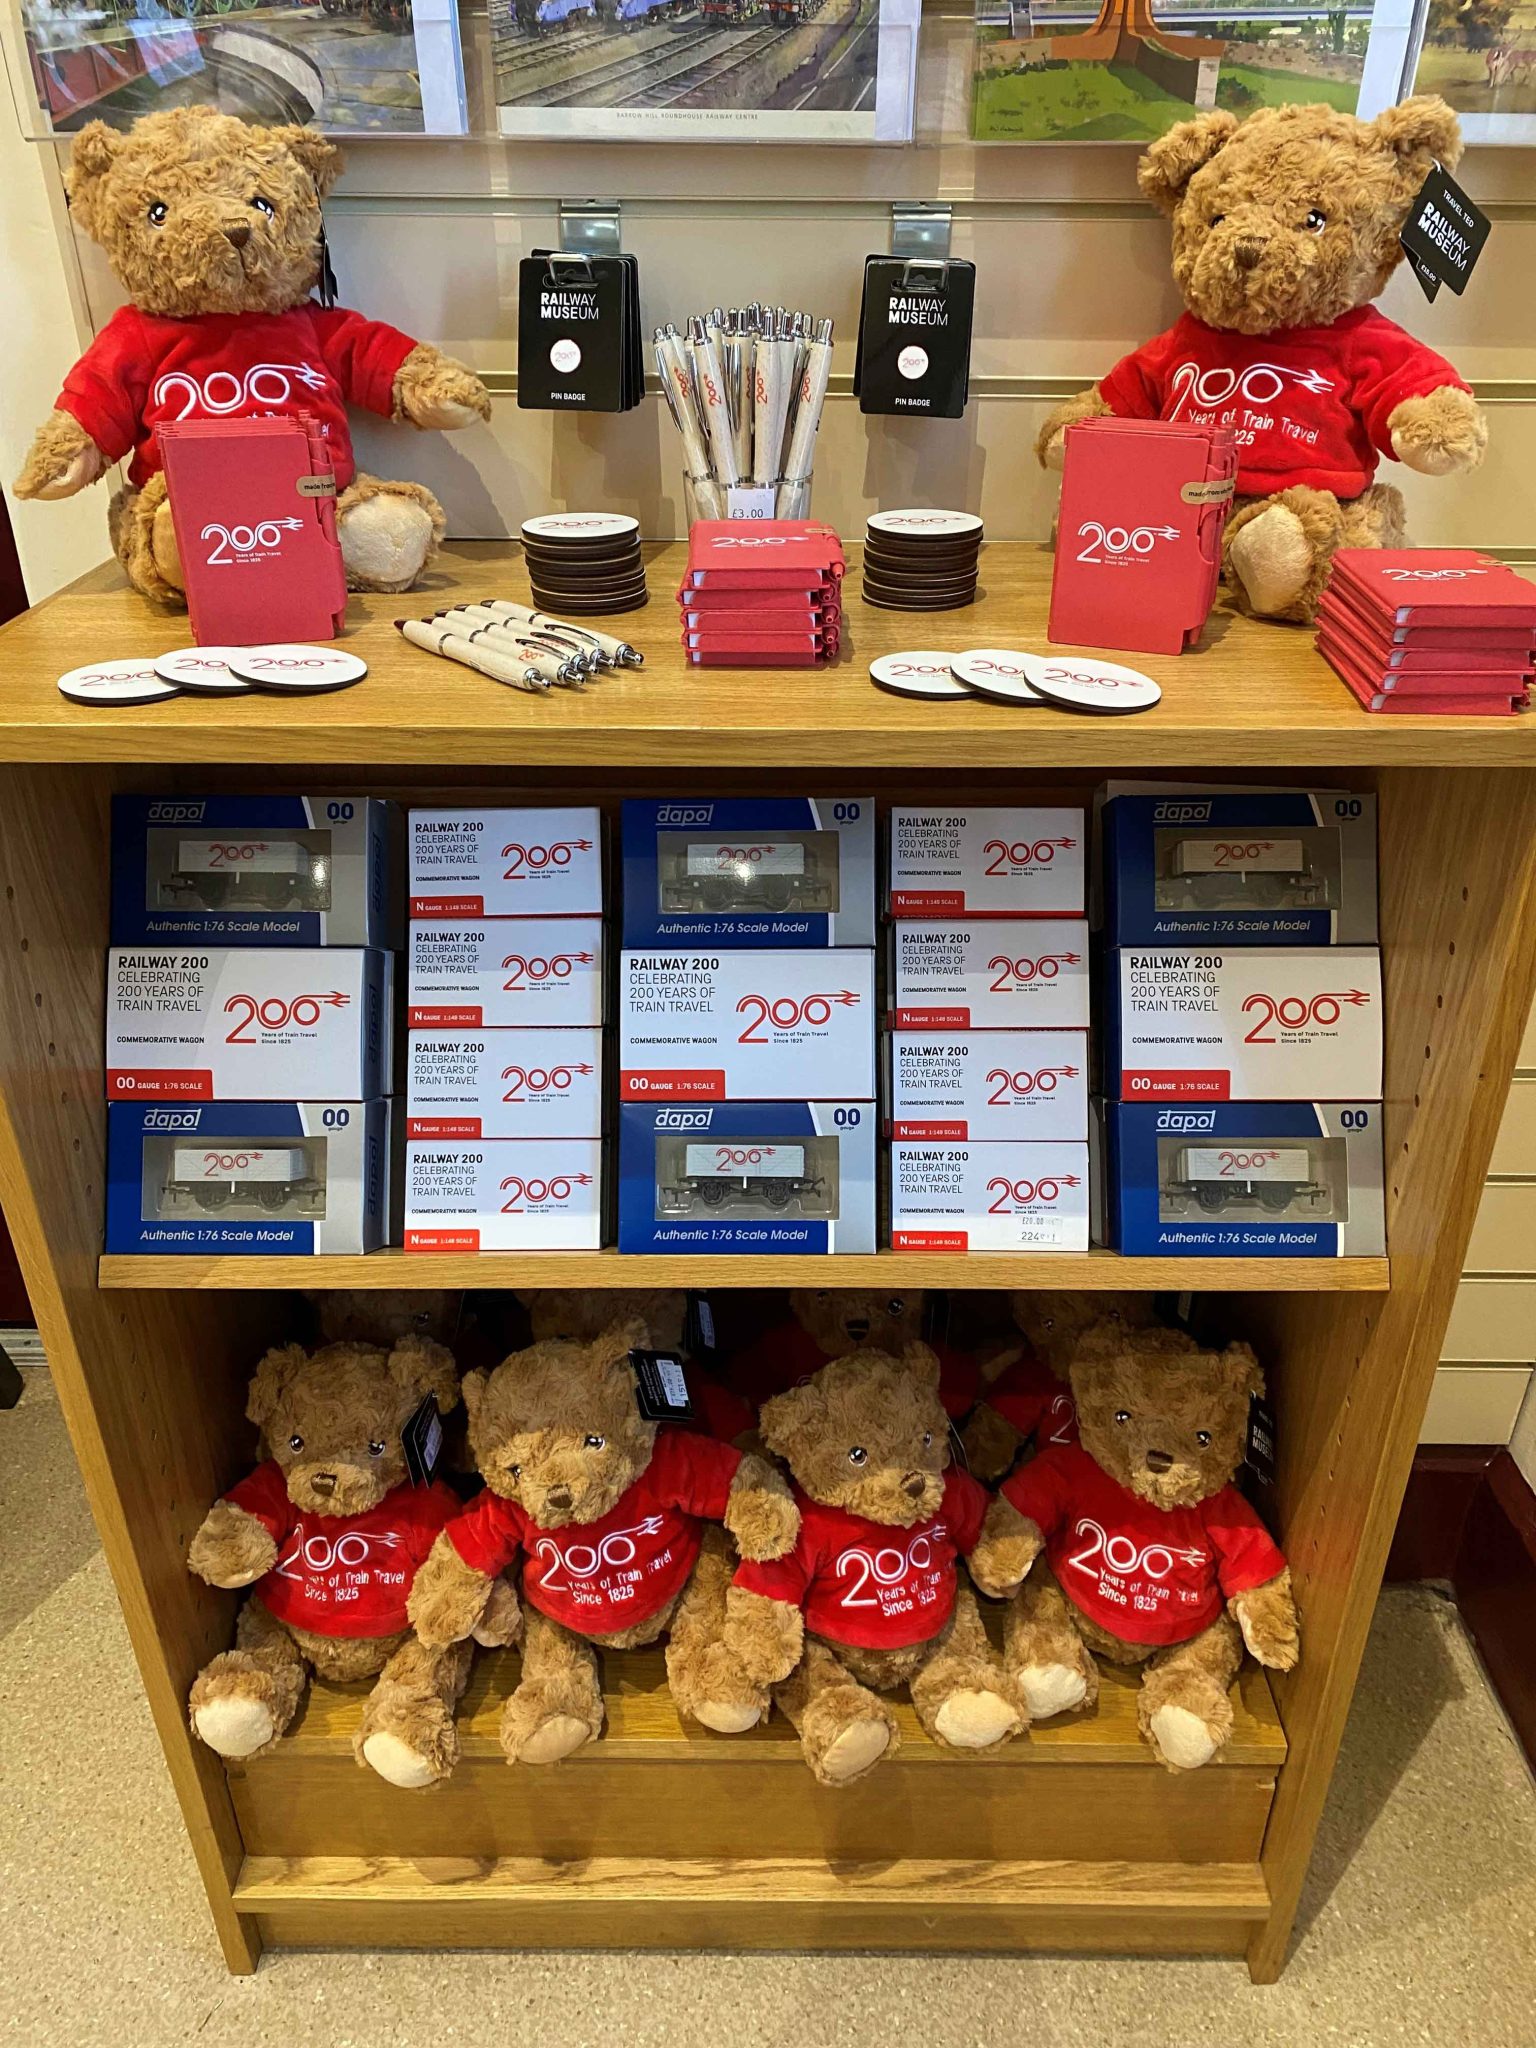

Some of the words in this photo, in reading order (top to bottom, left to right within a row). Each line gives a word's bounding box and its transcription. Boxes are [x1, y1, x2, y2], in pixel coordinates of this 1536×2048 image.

[1443, 190, 1462, 217] TRAVEL
[1464, 213, 1474, 228] TED
[1424, 202, 1470, 254] RAILWAY
[1418, 214, 1467, 271] MUSEUM
[541, 293, 596, 306] RAILWAY
[890, 297, 946, 311] RAILWAY
[541, 306, 598, 319] MUSEUM
[889, 311, 948, 325] MUSEUM
[155, 366, 290, 421] 200
[1189, 409, 1216, 425] Years
[1221, 408, 1236, 422] of
[1244, 410, 1273, 429] Train
[1282, 417, 1319, 444] Travel
[732, 509, 763, 518] £3.00
[883, 517, 947, 525] 200
[201, 521, 281, 564] 200
[711, 536, 786, 547] 200
[1077, 522, 1155, 563] 200
[1382, 569, 1467, 581] 200
[250, 658, 325, 670] 200
[1044, 668, 1120, 687] 200
[148, 802, 205, 823] dapol
[656, 804, 714, 826] dapol
[1154, 802, 1212, 824] dapol
[416, 823, 459, 832] RAILWAY
[463, 822, 483, 832] 200
[898, 818, 942, 827] RAILWAY
[946, 818, 966, 827] 200
[146, 921, 200, 931] Authentic
[204, 922, 224, 931] 1:76
[228, 922, 259, 931] Scale
[263, 921, 300, 932] Model
[657, 924, 712, 934] Authentic
[714, 924, 734, 933] 1:76
[737, 924, 769, 933] Scale
[772, 923, 808, 933] Model
[1154, 921, 1210, 932] Authentic
[1213, 921, 1234, 931] 1:76
[1237, 921, 1269, 931] Scale
[1272, 921, 1310, 931] Model
[416, 933, 461, 942] RAILWAY
[464, 933, 484, 942] 200
[903, 934, 947, 943] RAILWAY
[950, 934, 970, 943] 200
[118, 957, 177, 969] RAILWAY
[181, 957, 208, 969] 200
[630, 959, 688, 970] RAILWAY
[692, 959, 719, 970] 200
[1130, 957, 1190, 969] RAILWAY
[1194, 957, 1222, 969] 200
[118, 972, 200, 983] CELEBRATING
[630, 974, 712, 984] CELEBRATING
[1131, 972, 1215, 983] CELEBRATING
[117, 986, 142, 997] 200
[145, 986, 186, 997] YEARS
[189, 986, 204, 997] OF
[630, 988, 654, 998] 200
[657, 988, 696, 998] YEARS
[700, 988, 716, 998] OF
[1131, 986, 1156, 997] 200
[1159, 986, 1200, 997] YEARS
[1204, 986, 1220, 997] OF
[117, 1000, 155, 1011] TRAIN
[158, 1000, 201, 1011] TRAVEL
[630, 1002, 665, 1012] TRAIN
[670, 1002, 713, 1012] TRAVEL
[1131, 1000, 1169, 1011] TRAIN
[1172, 1000, 1218, 1011] TRAVEL
[224, 994, 320, 1043] 200
[736, 995, 831, 1043] 200
[1242, 994, 1340, 1043] 200
[415, 1044, 460, 1052] RAILWAY
[463, 1044, 484, 1053] 200
[900, 1047, 945, 1056] RAILWAY
[948, 1047, 968, 1055] 200
[142, 1109, 201, 1130] dapol
[655, 1108, 713, 1131] dapol
[1157, 1110, 1216, 1132] dapol
[716, 1148, 761, 1171] 200
[900, 1152, 944, 1160] RAILWAY
[948, 1152, 968, 1160] 200
[204, 1153, 249, 1176] 200
[1218, 1151, 1265, 1176] 200
[140, 1231, 195, 1240] Authentic
[197, 1231, 218, 1240] 1:76
[221, 1231, 253, 1240] Scale
[256, 1231, 294, 1241] Model
[653, 1230, 709, 1240] Authentic
[712, 1230, 732, 1240] 1:76
[735, 1230, 767, 1240] Scale
[771, 1230, 808, 1240] Model
[1159, 1233, 1216, 1244] Authentic
[1219, 1233, 1240, 1243] 1:76
[1243, 1233, 1276, 1243] Scale
[1279, 1233, 1317, 1244] Model
[276, 1523, 369, 1580] 200
[1069, 1518, 1173, 1580] 200
[536, 1532, 635, 1591] 200
[346, 1572, 369, 1585] Train
[374, 1569, 405, 1584] Travel
[616, 1569, 642, 1583] Train
[836, 1536, 931, 1607] 200
[1100, 1567, 1126, 1589] Years
[335, 1587, 359, 1602] 1825
[573, 1591, 602, 1605] Since
[608, 1585, 635, 1603] 1825
[877, 1586, 905, 1602] Years
[1098, 1583, 1127, 1605] Since
[1134, 1596, 1157, 1611] 1825
[882, 1599, 913, 1616] Since
